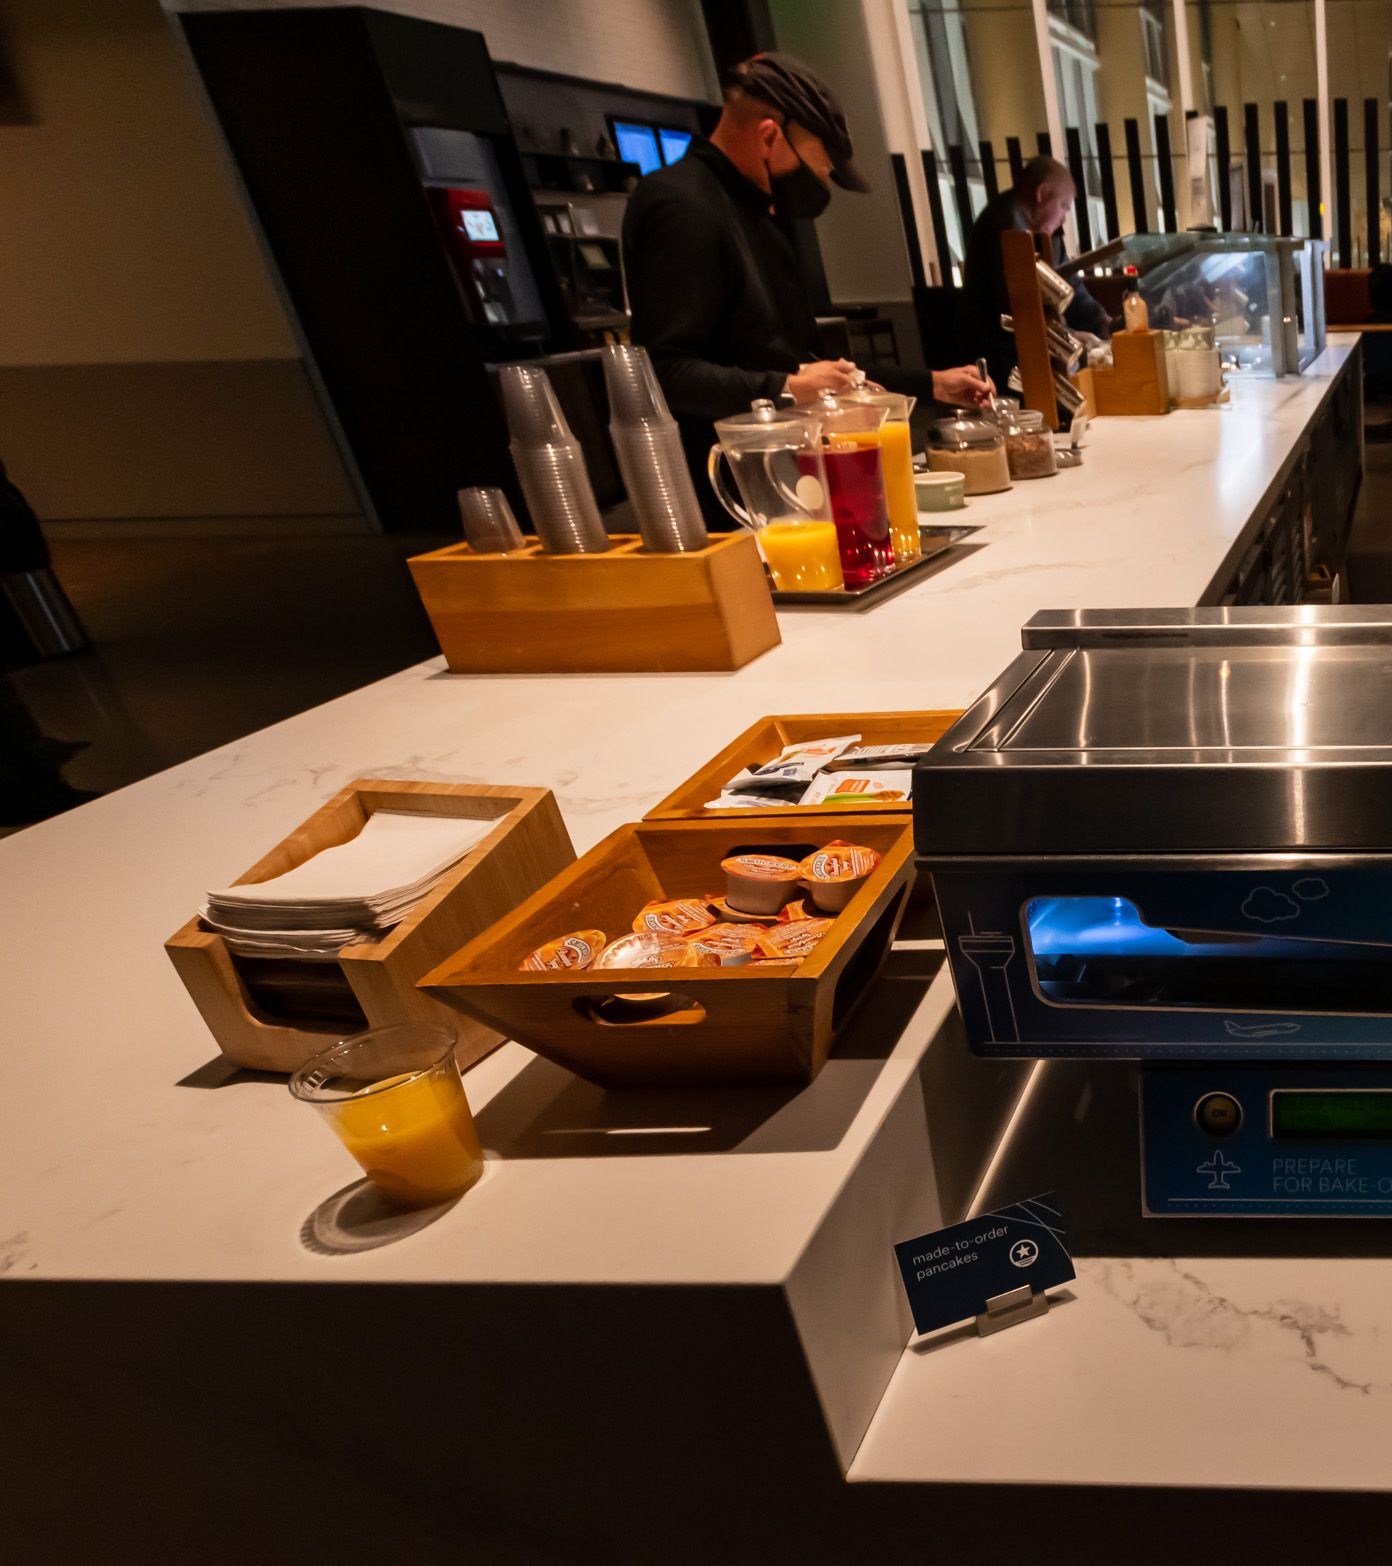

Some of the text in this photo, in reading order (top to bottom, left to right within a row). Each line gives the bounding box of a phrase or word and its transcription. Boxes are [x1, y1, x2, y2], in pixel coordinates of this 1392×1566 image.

[1211, 1108, 1228, 1119] OK
[1272, 1158, 1357, 1175] PREPARE
[1272, 1177, 1314, 1193] FOR
[912, 1225, 1009, 1266] made-to-order
[916, 1252, 979, 1282] pancakes
